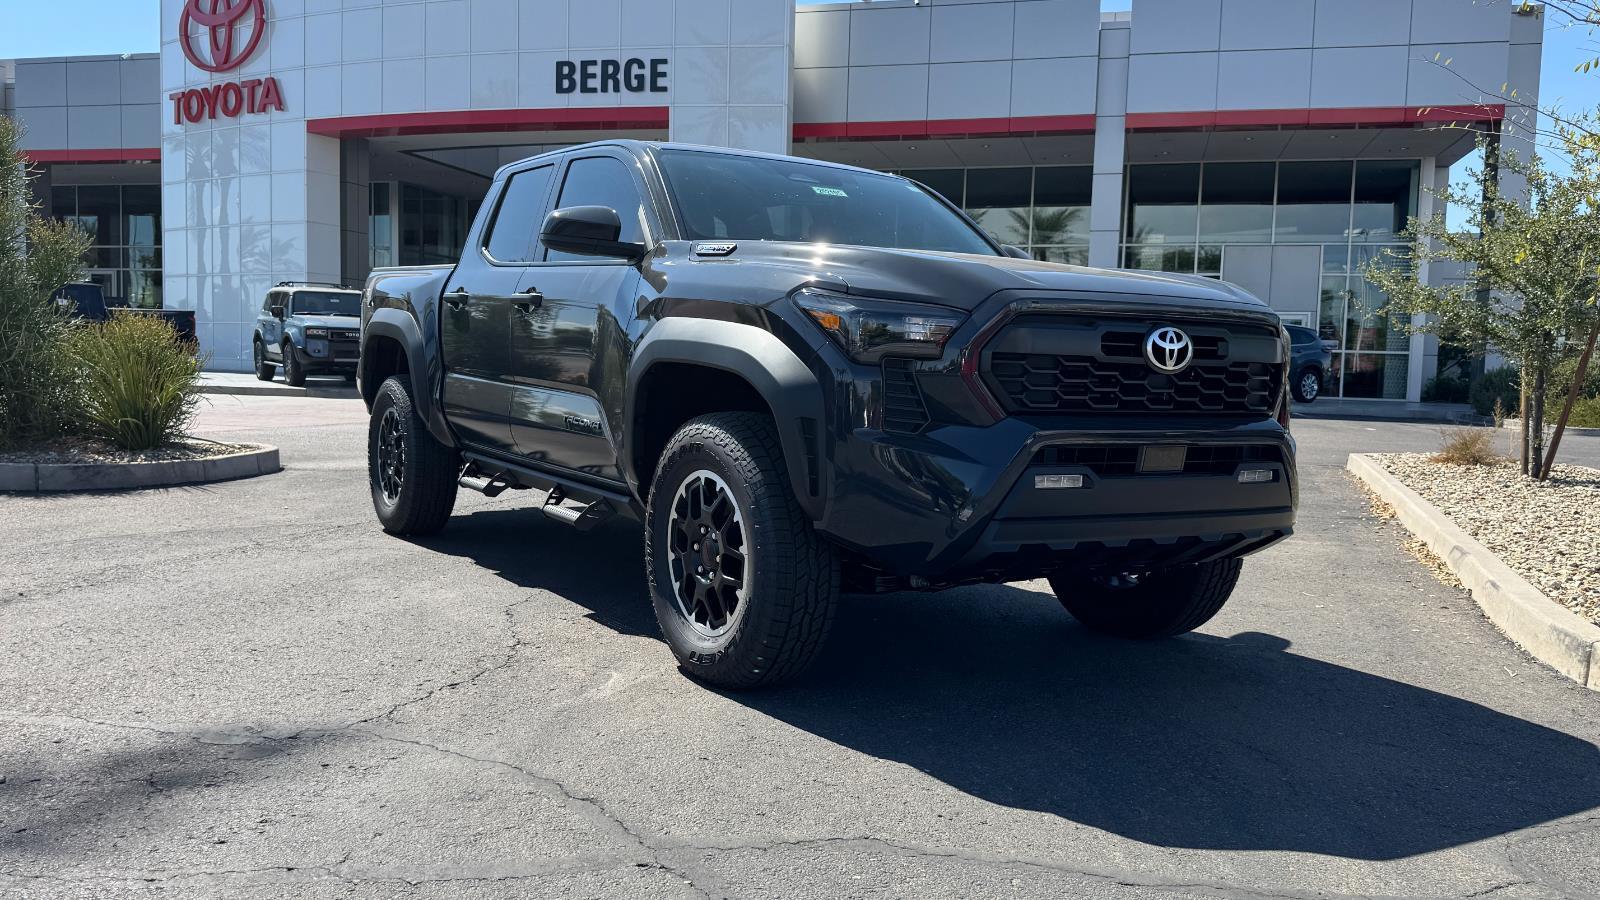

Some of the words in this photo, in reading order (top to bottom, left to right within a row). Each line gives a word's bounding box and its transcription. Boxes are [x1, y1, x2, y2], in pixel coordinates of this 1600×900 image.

[555, 58, 668, 94] BERGE
[169, 76, 284, 125] TOYOTA
[563, 414, 601, 430] TACOMA
